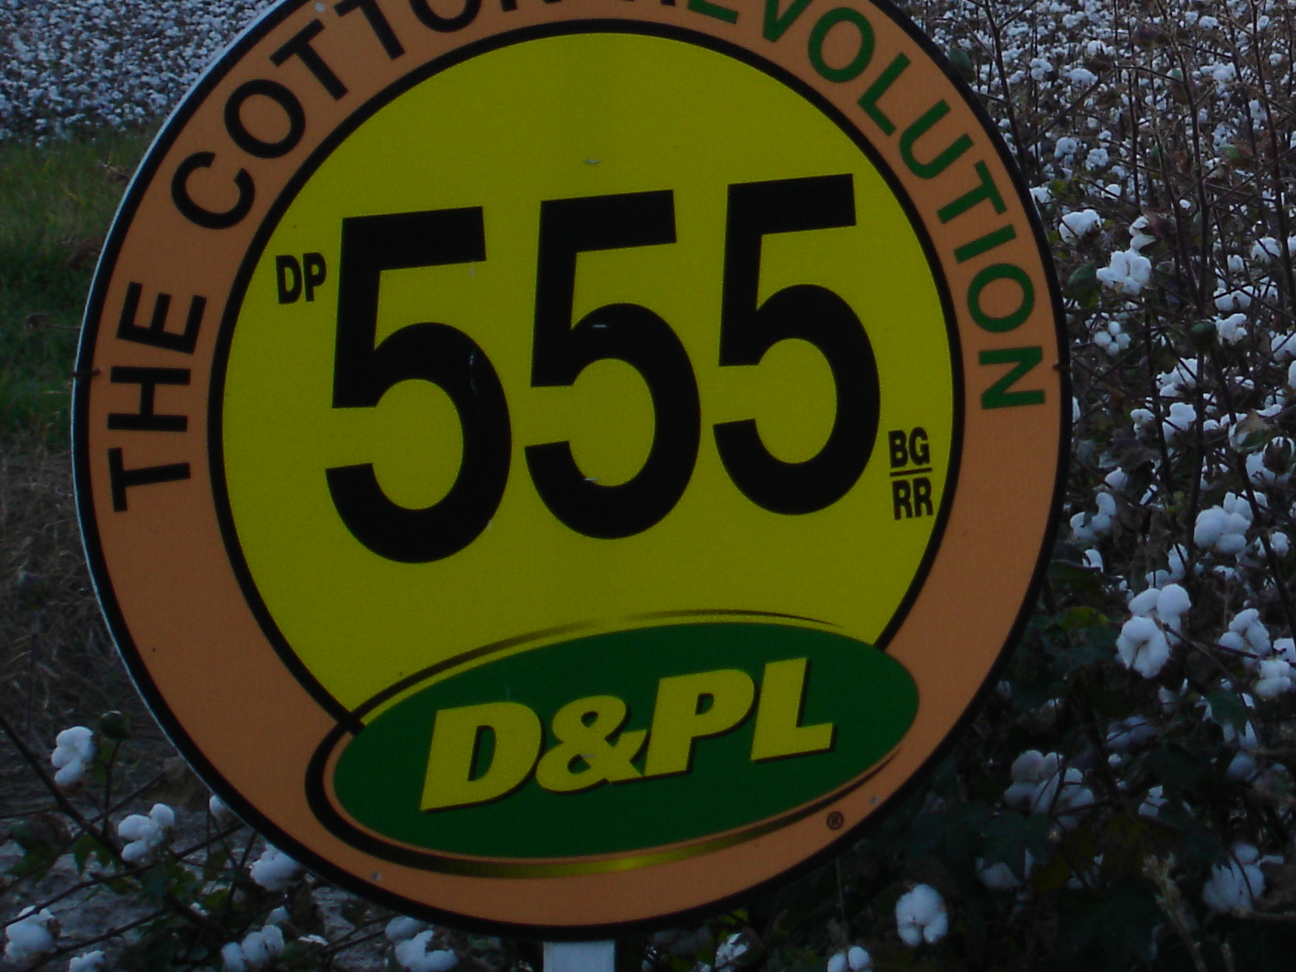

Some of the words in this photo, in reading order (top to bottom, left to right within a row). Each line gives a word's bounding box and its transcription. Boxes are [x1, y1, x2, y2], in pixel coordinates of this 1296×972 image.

[275, 251, 327, 305] DP
[107, 281, 207, 512] THE
[325, 173, 881, 564] 555
[888, 427, 931, 469] BG
[891, 478, 934, 521] RR
[419, 657, 836, 813] D&PL
